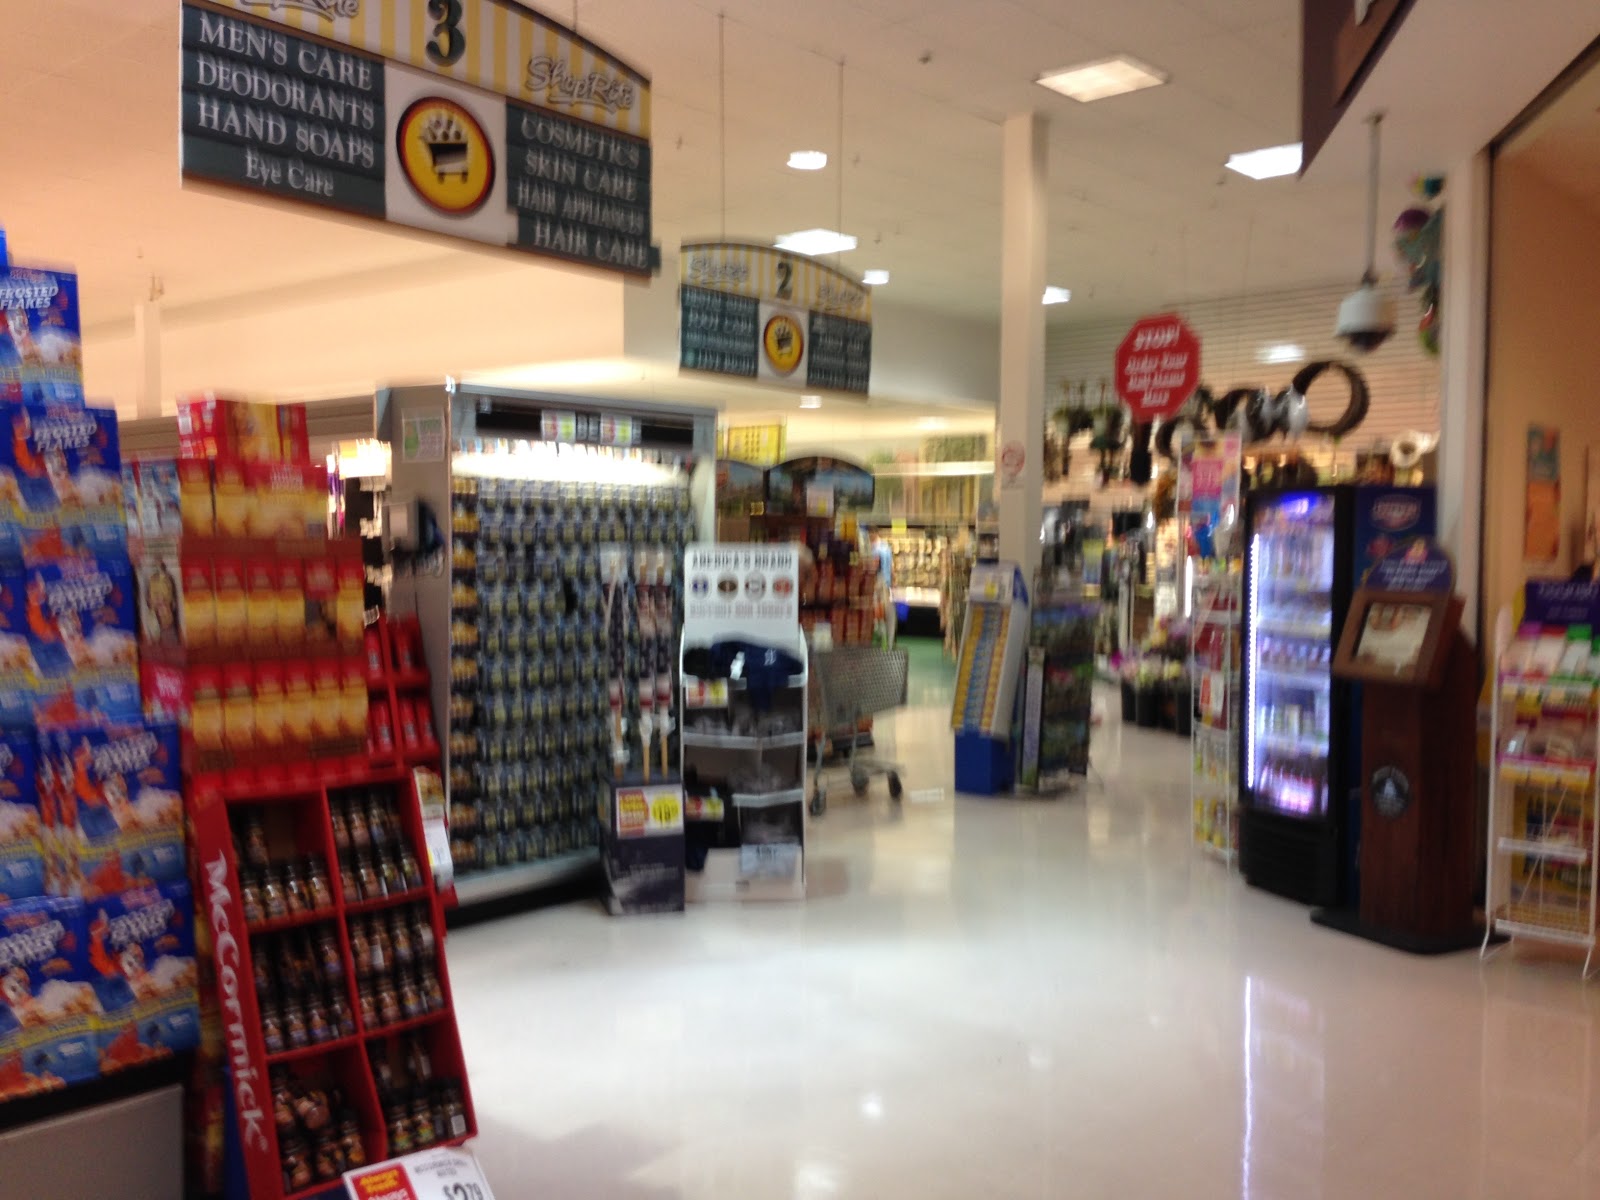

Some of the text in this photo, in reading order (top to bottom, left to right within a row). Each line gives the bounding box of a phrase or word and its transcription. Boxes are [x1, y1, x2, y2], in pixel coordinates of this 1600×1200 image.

[199, 16, 372, 91] MEN'S CARE
[425, 0, 467, 67] 3
[197, 57, 375, 130] DEODORANTS
[198, 99, 375, 169] HAND SOAPS
[521, 112, 640, 169] COSMETICS
[245, 152, 334, 197] Eye Care
[517, 178, 556, 215] HAIR
[525, 150, 637, 201] SKIN CARE
[534, 217, 649, 269] HAIR CARE
[0, 286, 59, 299] FROSTED
[0, 297, 51, 310] FLAKES
[777, 262, 793, 298] 2
[205, 848, 269, 1152] McCormick
